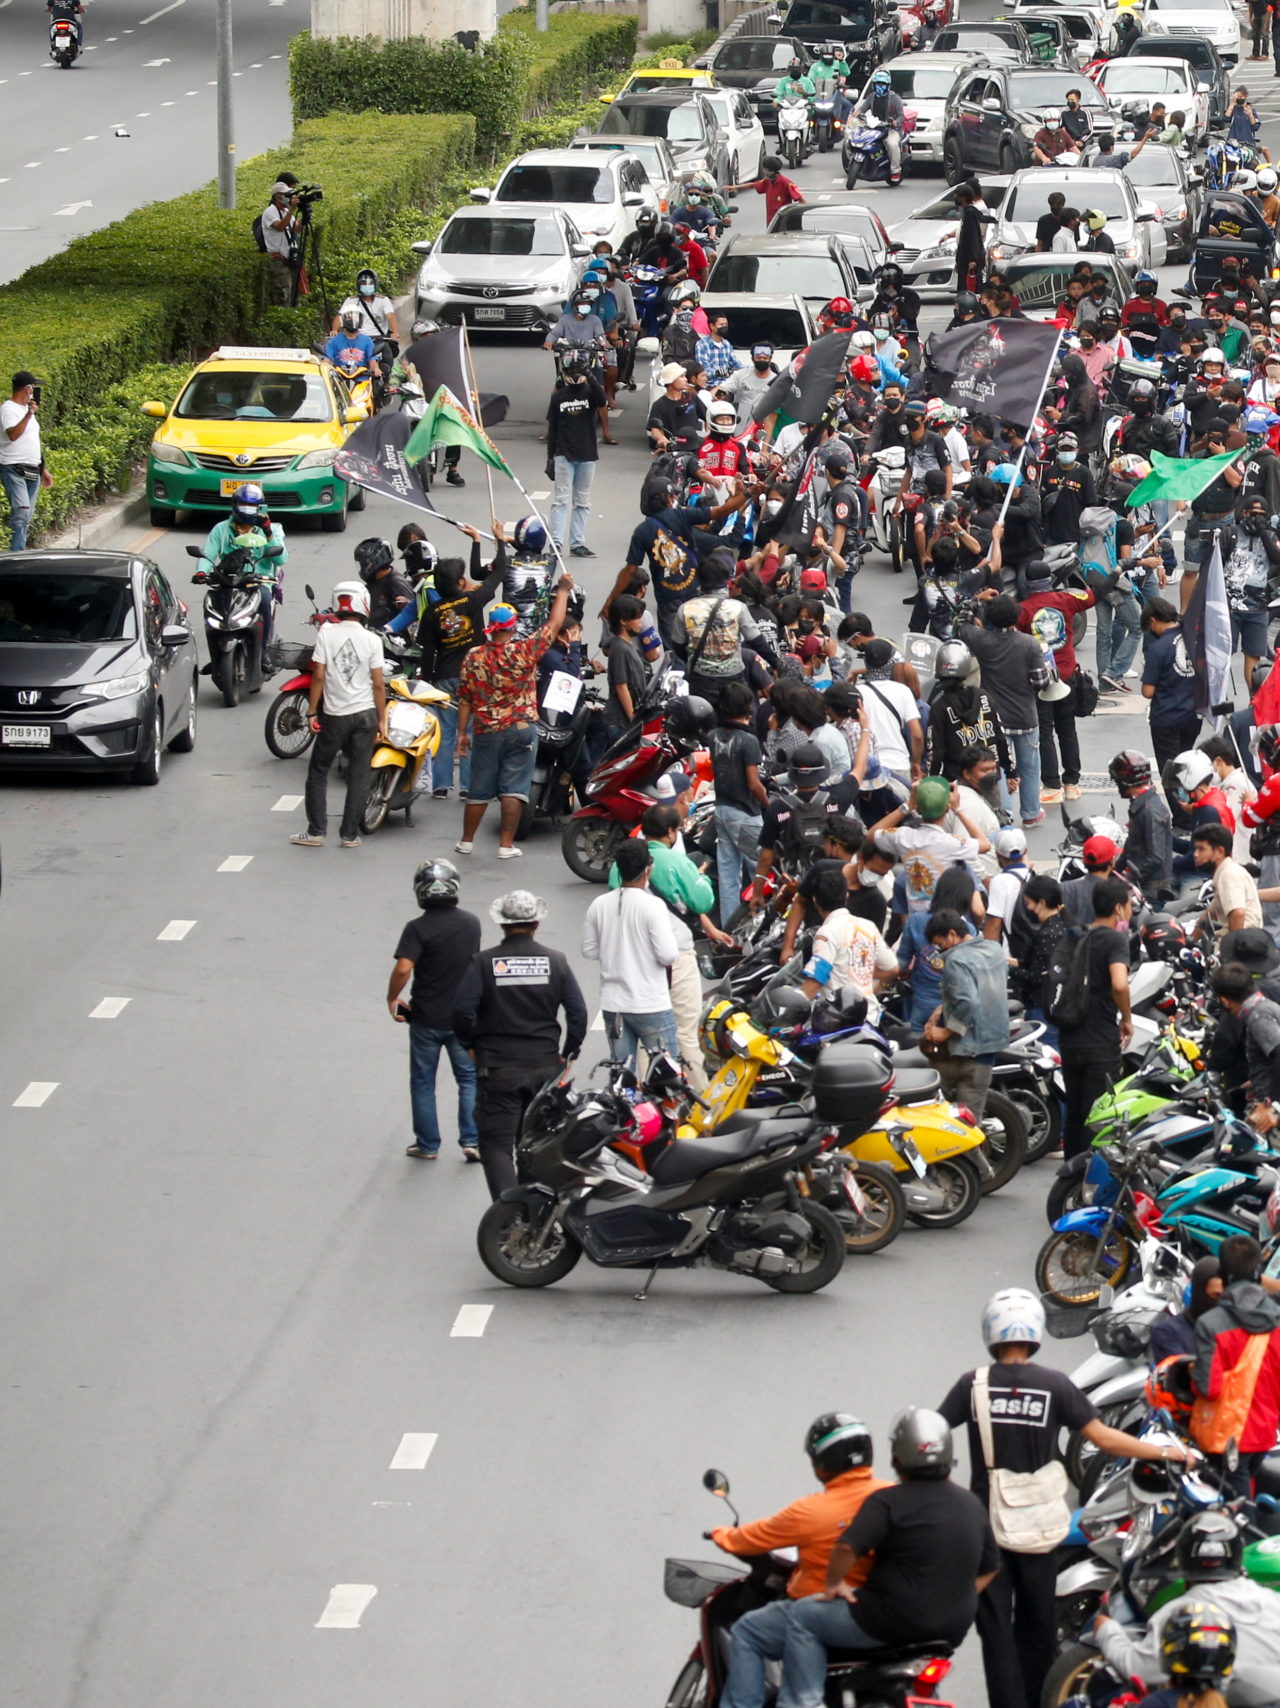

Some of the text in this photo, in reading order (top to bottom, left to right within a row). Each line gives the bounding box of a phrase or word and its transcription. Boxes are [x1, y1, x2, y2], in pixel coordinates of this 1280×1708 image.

[25, 727, 49, 738] 9173
[956, 720, 995, 747] YOUR
[760, 1072, 785, 1081] ENEOS
[985, 1395, 1043, 1418] asis
